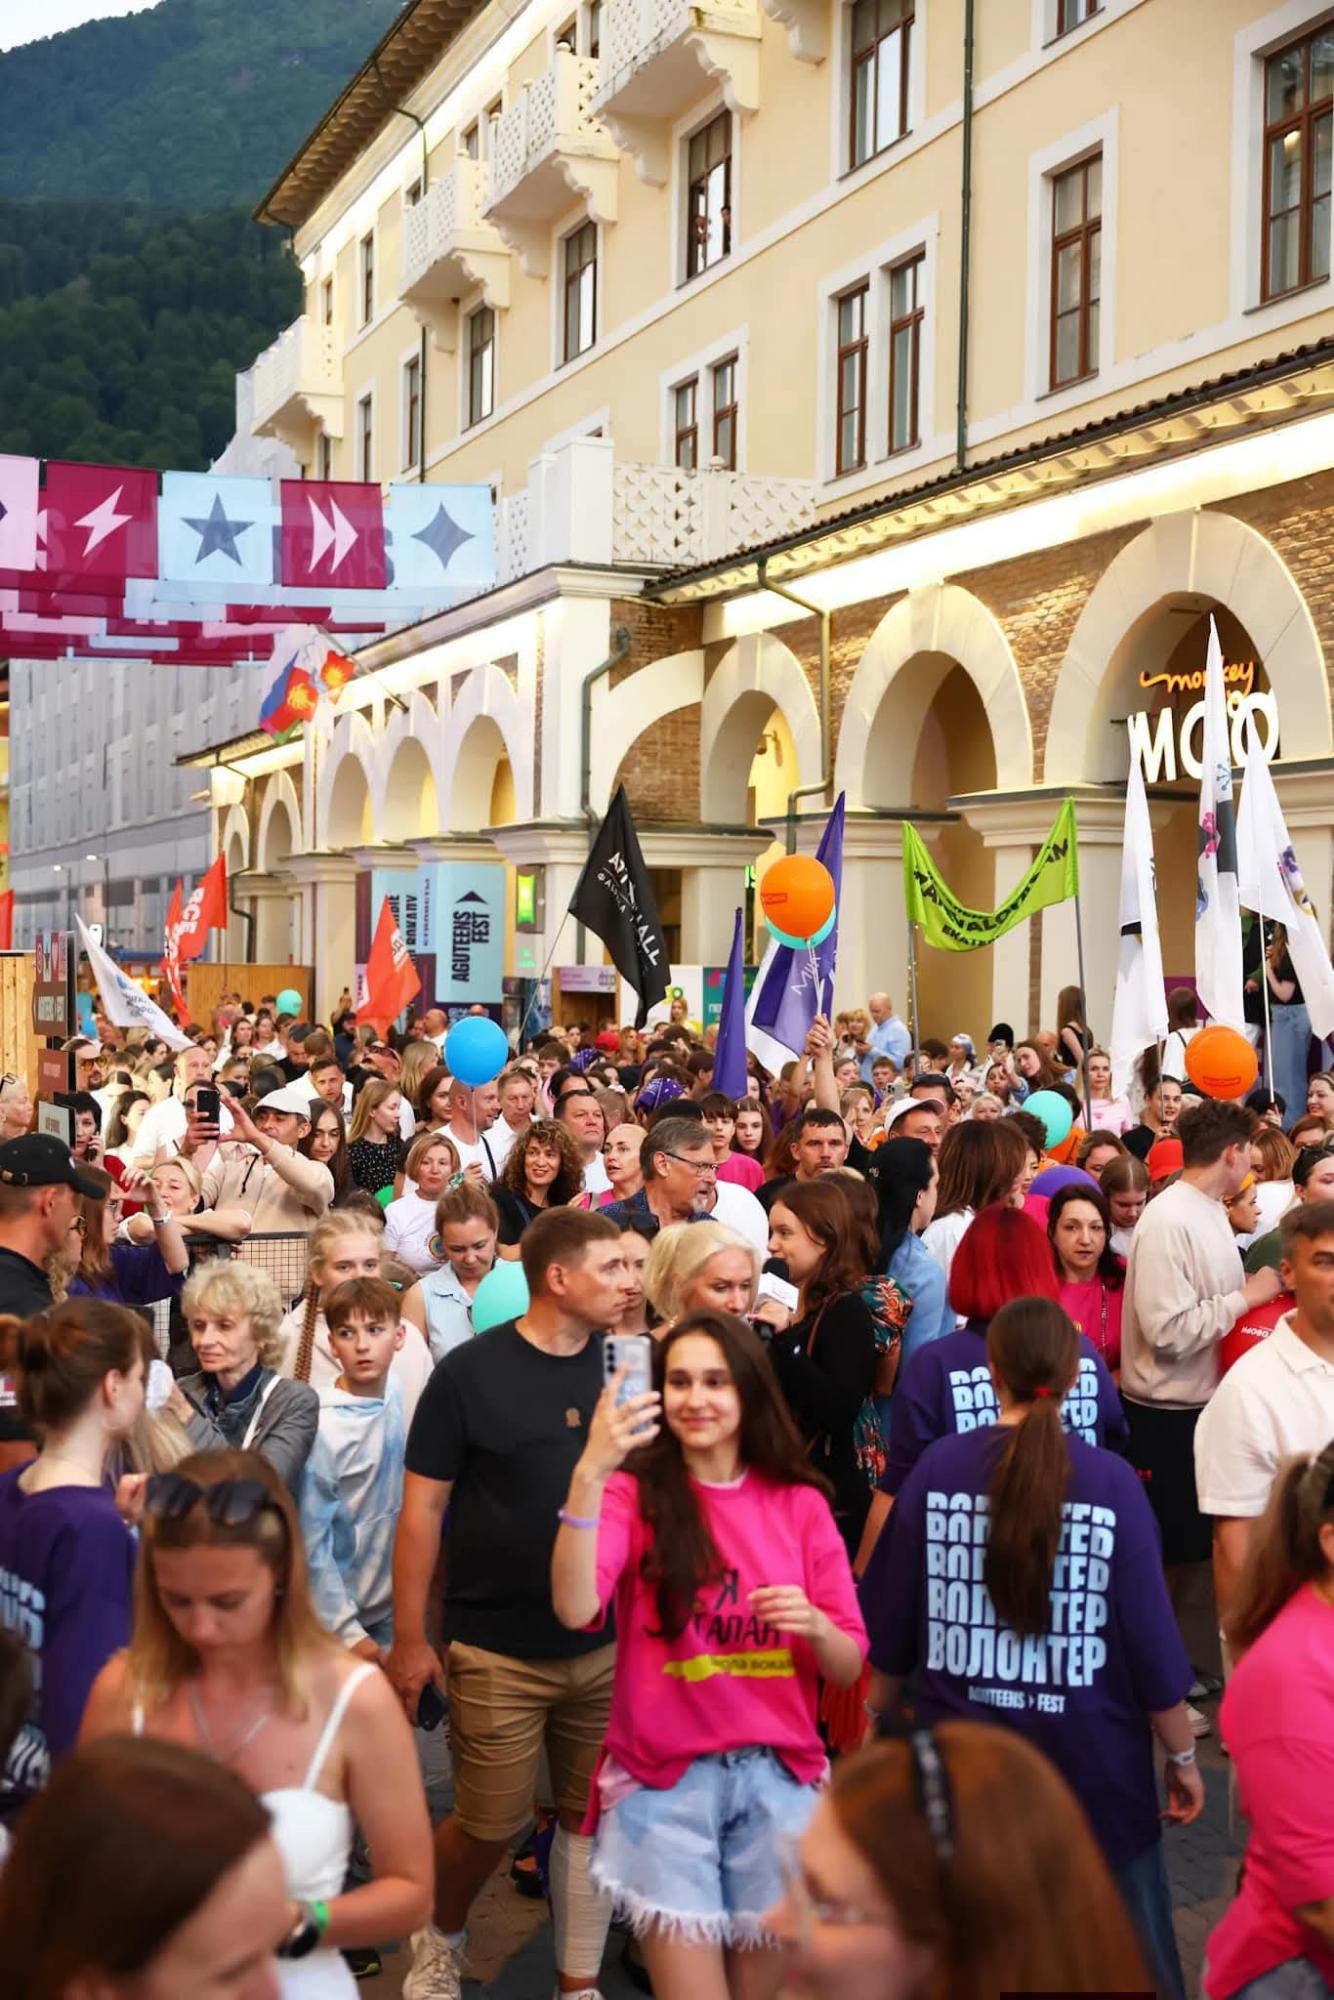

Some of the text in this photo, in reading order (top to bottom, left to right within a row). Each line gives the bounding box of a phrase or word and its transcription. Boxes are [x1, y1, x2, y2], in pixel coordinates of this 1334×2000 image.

[452, 910, 471, 982] AGUTEENS
[472, 912, 490, 943] FEST
[926, 1620, 1107, 1686] ВОЛОНТЕР
[1037, 1693, 1065, 1712] FEST
